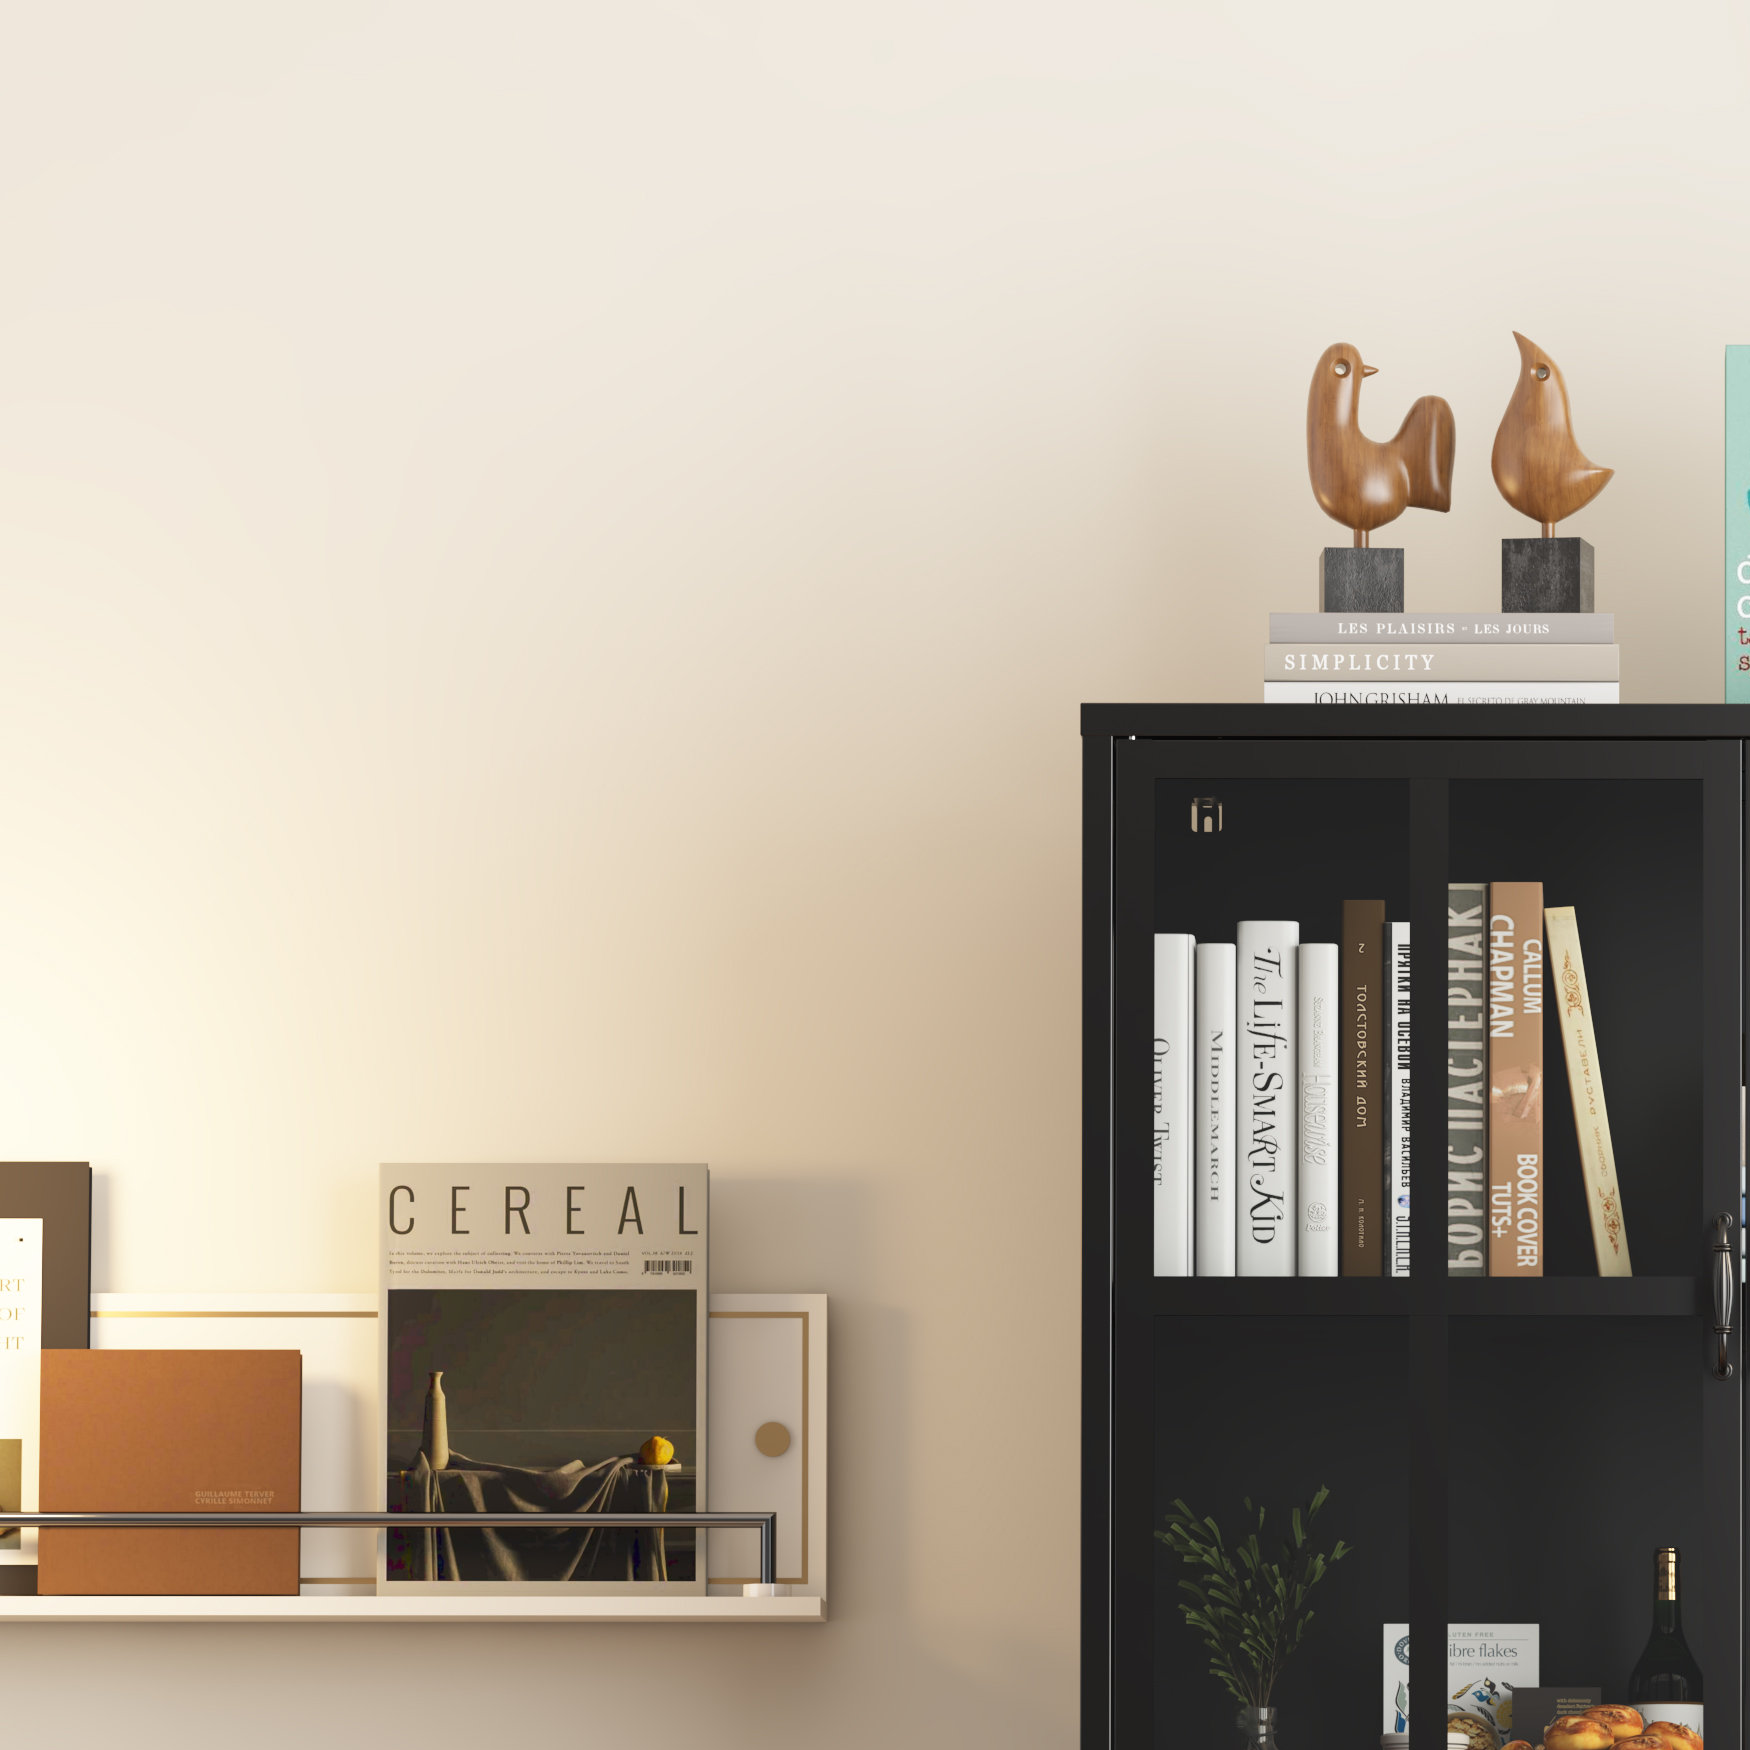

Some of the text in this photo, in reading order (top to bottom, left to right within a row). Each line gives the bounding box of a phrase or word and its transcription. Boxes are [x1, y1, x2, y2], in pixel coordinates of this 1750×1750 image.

[1284, 654, 1435, 671] SIMPLICITY
[1337, 622, 1550, 635] LES PLAISIRS LES JOURS
[1253, 947, 1283, 994] The
[1490, 914, 1514, 1038] CHAPMAN
[1522, 938, 1542, 1014] CALLUM
[1356, 984, 1367, 1129] ТОЛСТОВСКИЙ ДОМ
[1447, 904, 1483, 1269] БОРИС ПАСТЕРНАК
[1577, 1028, 1598, 1116] РУСТАВЕЛИ
[1210, 1030, 1223, 1202] MIDDLEMARCH
[1301, 1072, 1332, 1168] Housewise
[1400, 1078, 1410, 1188] ВЛАДИМИР ВАСИЛЬЕВ
[389, 1185, 698, 1235] CEREAL
[1491, 1181, 1512, 1239] TUTS+
[1516, 1153, 1538, 1268] BOOK COVER
[195, 1490, 275, 1498] GUILLAUME TERVER
[195, 1497, 227, 1505] CYRILLE
[1448, 1643, 1518, 1658] ibre flakes
